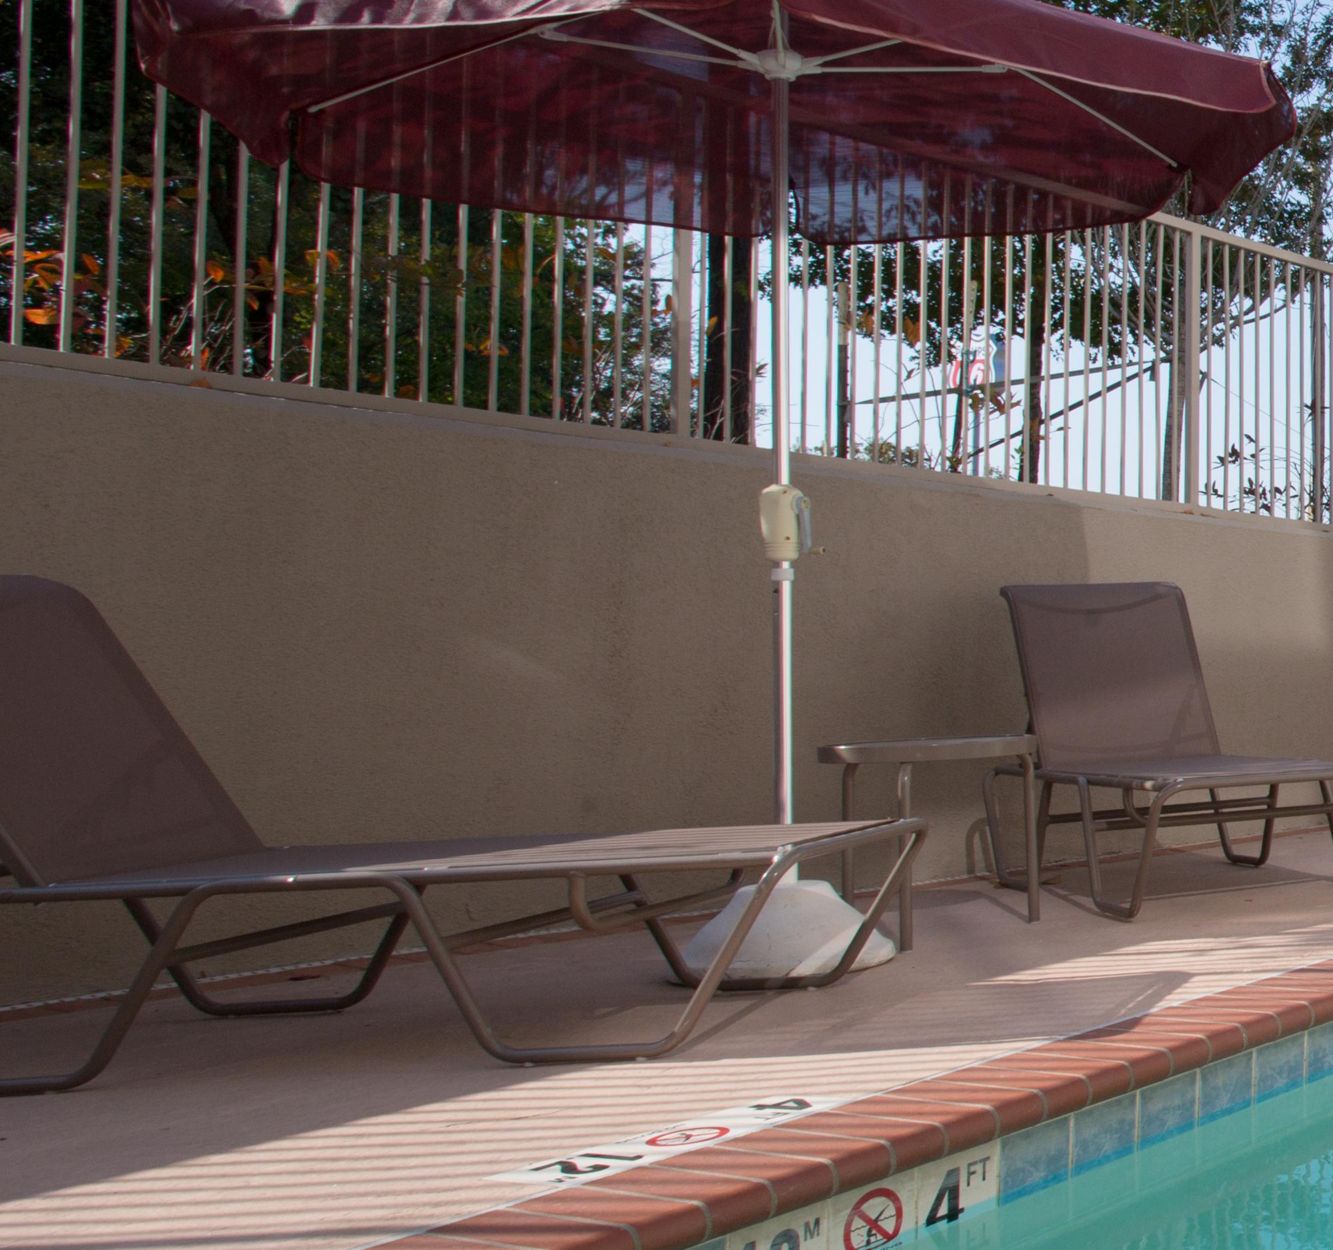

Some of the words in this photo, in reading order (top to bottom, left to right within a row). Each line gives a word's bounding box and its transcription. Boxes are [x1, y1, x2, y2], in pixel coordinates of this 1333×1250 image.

[750, 1097, 813, 1111] 4
[925, 1166, 965, 1229] 4
[966, 1156, 991, 1188] FT
[803, 1216, 821, 1243] M
